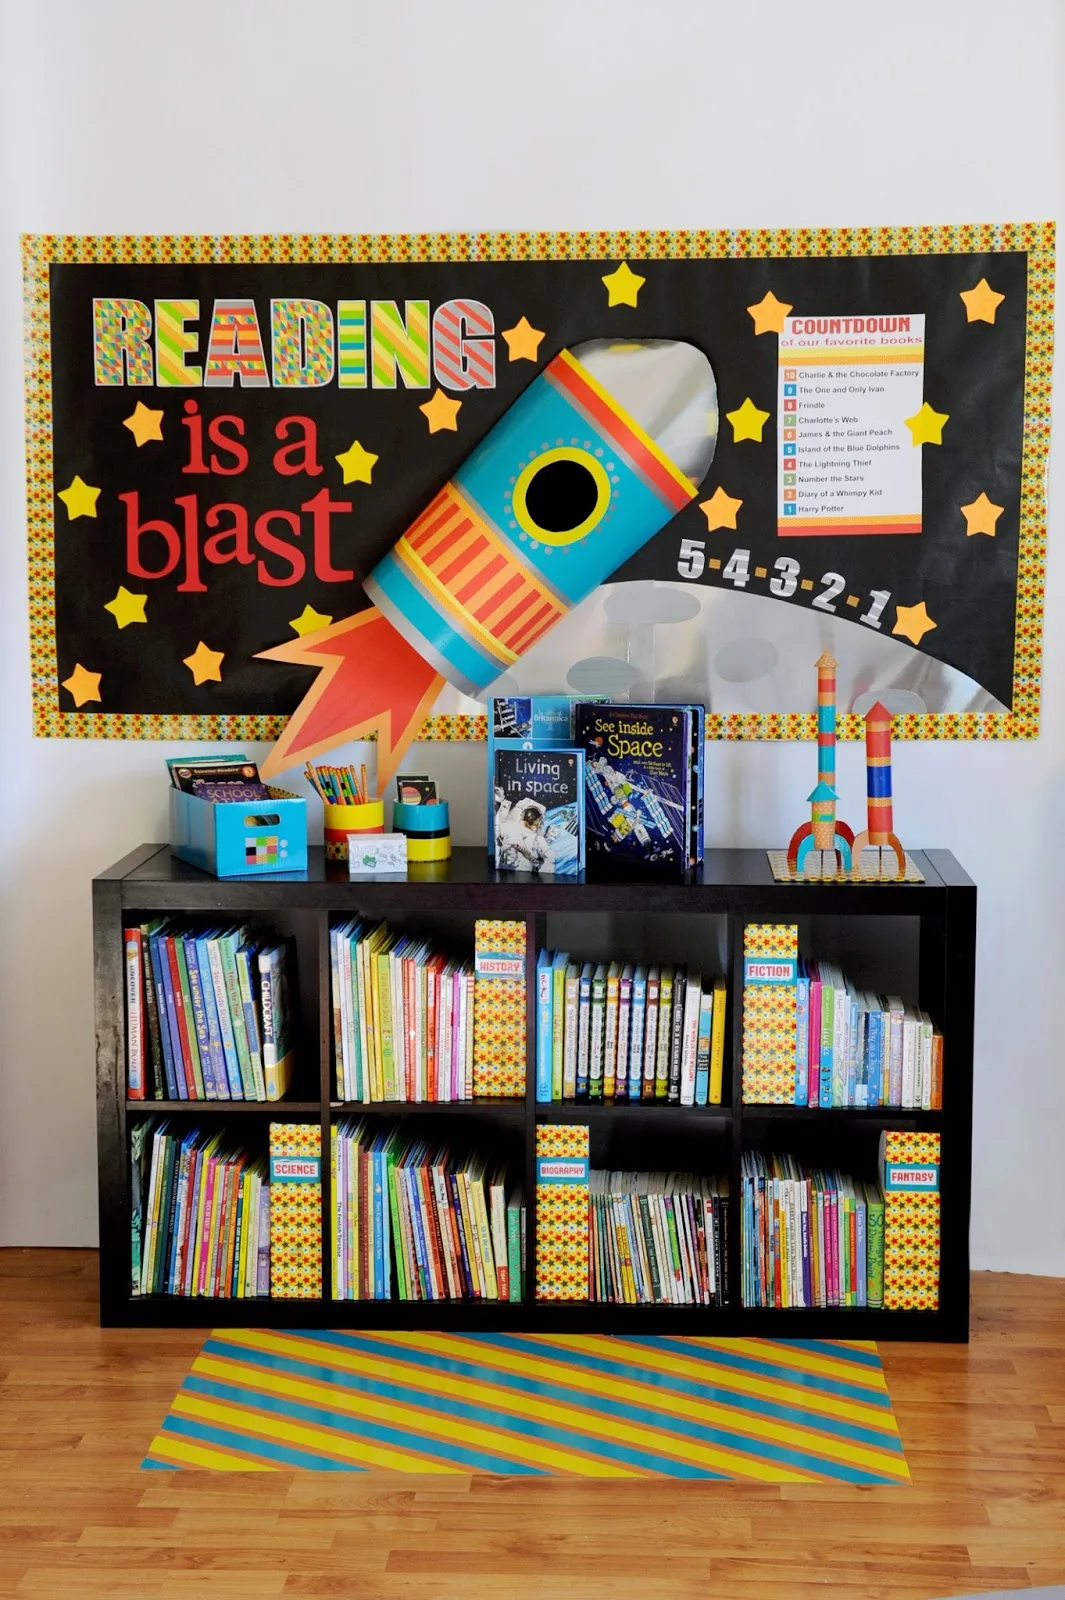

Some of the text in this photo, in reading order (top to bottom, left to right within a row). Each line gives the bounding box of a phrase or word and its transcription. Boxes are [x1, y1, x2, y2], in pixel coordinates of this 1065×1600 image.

[792, 317, 910, 334] COUNTDOWN
[92, 297, 496, 391] READING
[825, 337, 876, 345] favorite
[881, 336, 922, 344] books
[849, 386, 866, 394] Only
[181, 400, 323, 476] is a
[815, 461, 850, 469] Lightning
[118, 487, 354, 593] blast
[595, 719, 653, 735] See inside
[607, 734, 663, 759] Space
[516, 758, 560, 780] Living
[207, 789, 261, 798] SCHOOL
[508, 780, 568, 796] in space
[480, 961, 519, 971] HISTORY
[749, 965, 791, 977] FICTION
[226, 970, 242, 1018] Telling the Time
[189, 968, 208, 1040] See under the Sea
[213, 971, 230, 1036] See inside Science
[260, 980, 273, 1037] CHILDCRAFT
[382, 1010, 390, 1025] Book
[130, 1011, 139, 1048] HUMAN
[553, 1014, 561, 1044] NATE
[130, 1049, 140, 1073] BODY
[275, 1164, 316, 1175] SCIENCE
[541, 1166, 584, 1175] BIOGRAPHY
[892, 1172, 934, 1182] FANTASY
